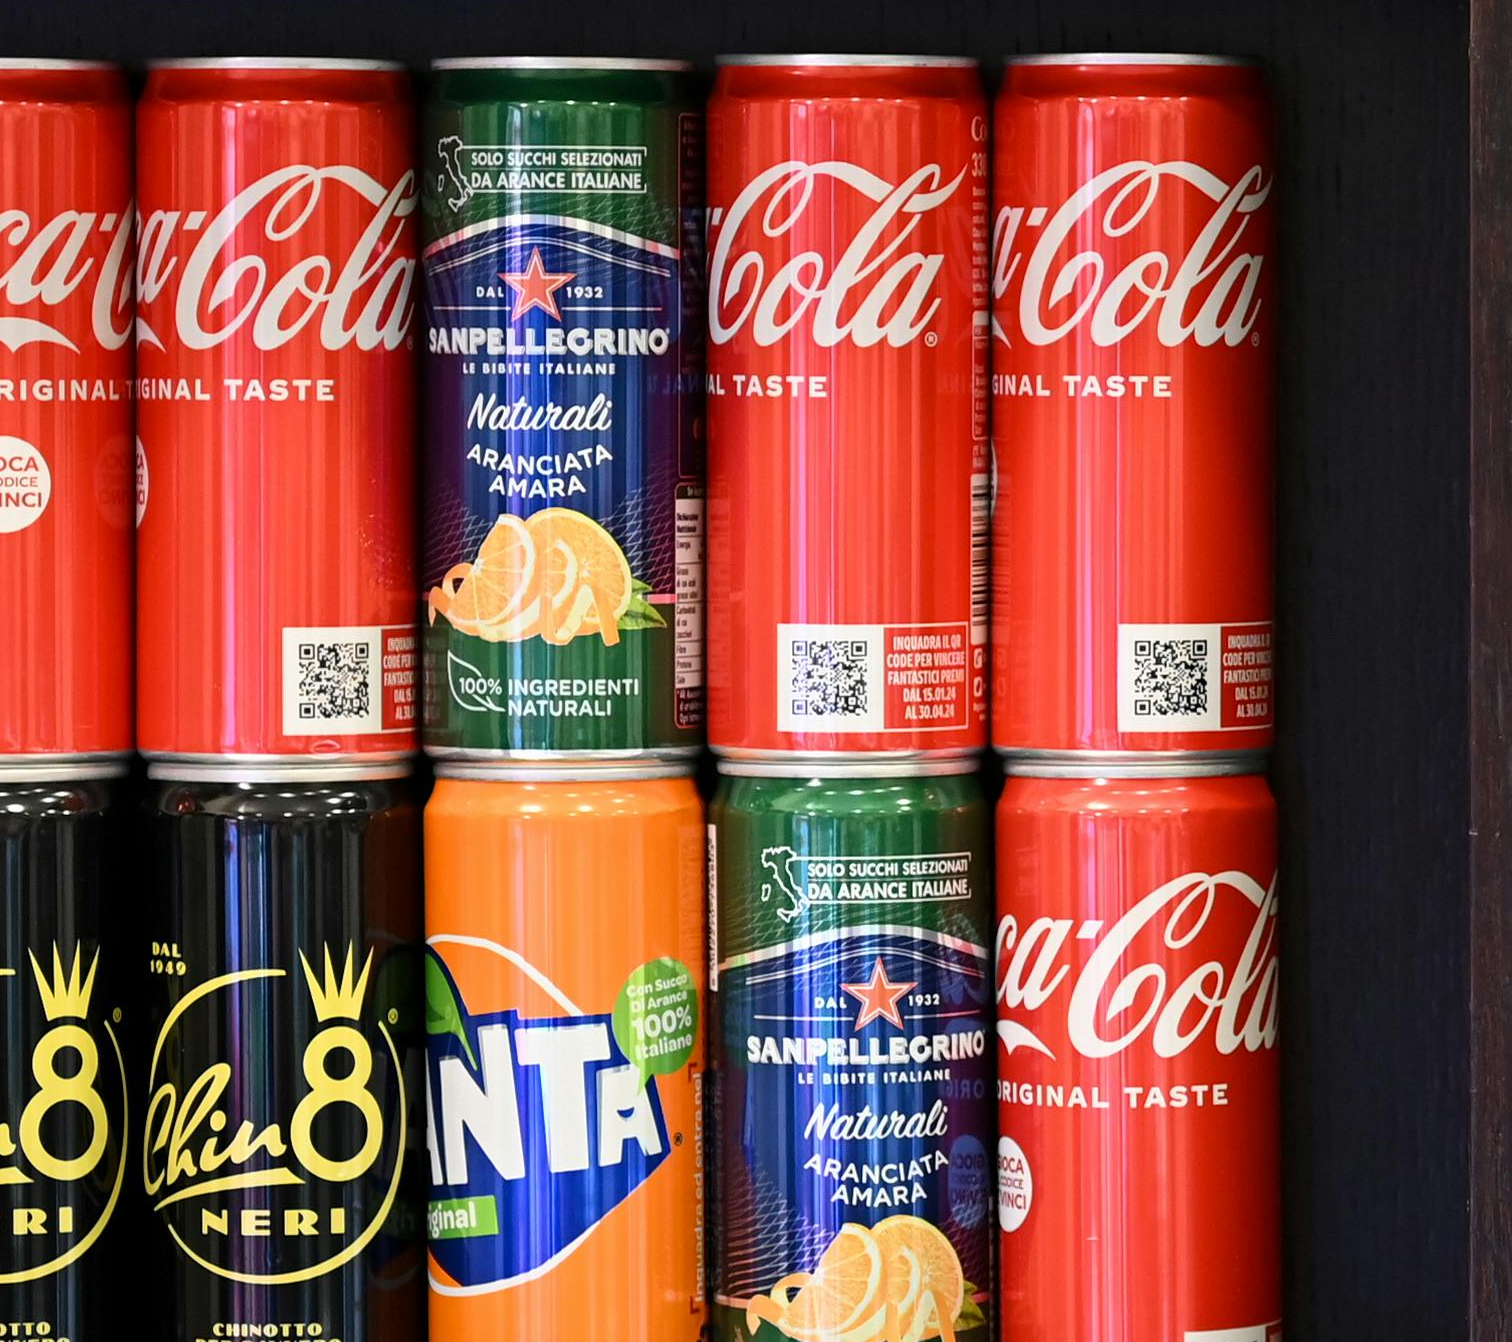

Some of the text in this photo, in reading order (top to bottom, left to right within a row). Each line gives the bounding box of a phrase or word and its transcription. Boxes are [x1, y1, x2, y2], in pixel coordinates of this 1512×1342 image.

[567, 286, 603, 298] 1932
[430, 325, 667, 355] SANPELLEGRINO
[733, 375, 828, 398] TASTE
[1063, 375, 1172, 397] TASTE
[468, 392, 612, 432] Naturali
[467, 444, 613, 476] ARANCIATA
[488, 474, 585, 498] AMARA
[893, 635, 941, 651] INQUADRA
[943, 635, 949, 648] IL
[887, 651, 964, 668] CODE PER VINCERE
[459, 675, 639, 697] 100% INGREDIENTI
[888, 670, 939, 685] FANTASTICI
[903, 686, 956, 702] DAL 15.01.24
[507, 698, 612, 717] NATURALI
[905, 704, 954, 719] AL 30.04.24
[626, 974, 687, 997] Con Succo
[631, 990, 687, 1012] Di Arance
[632, 1004, 692, 1040] 100%
[635, 1034, 692, 1059] Italiane
